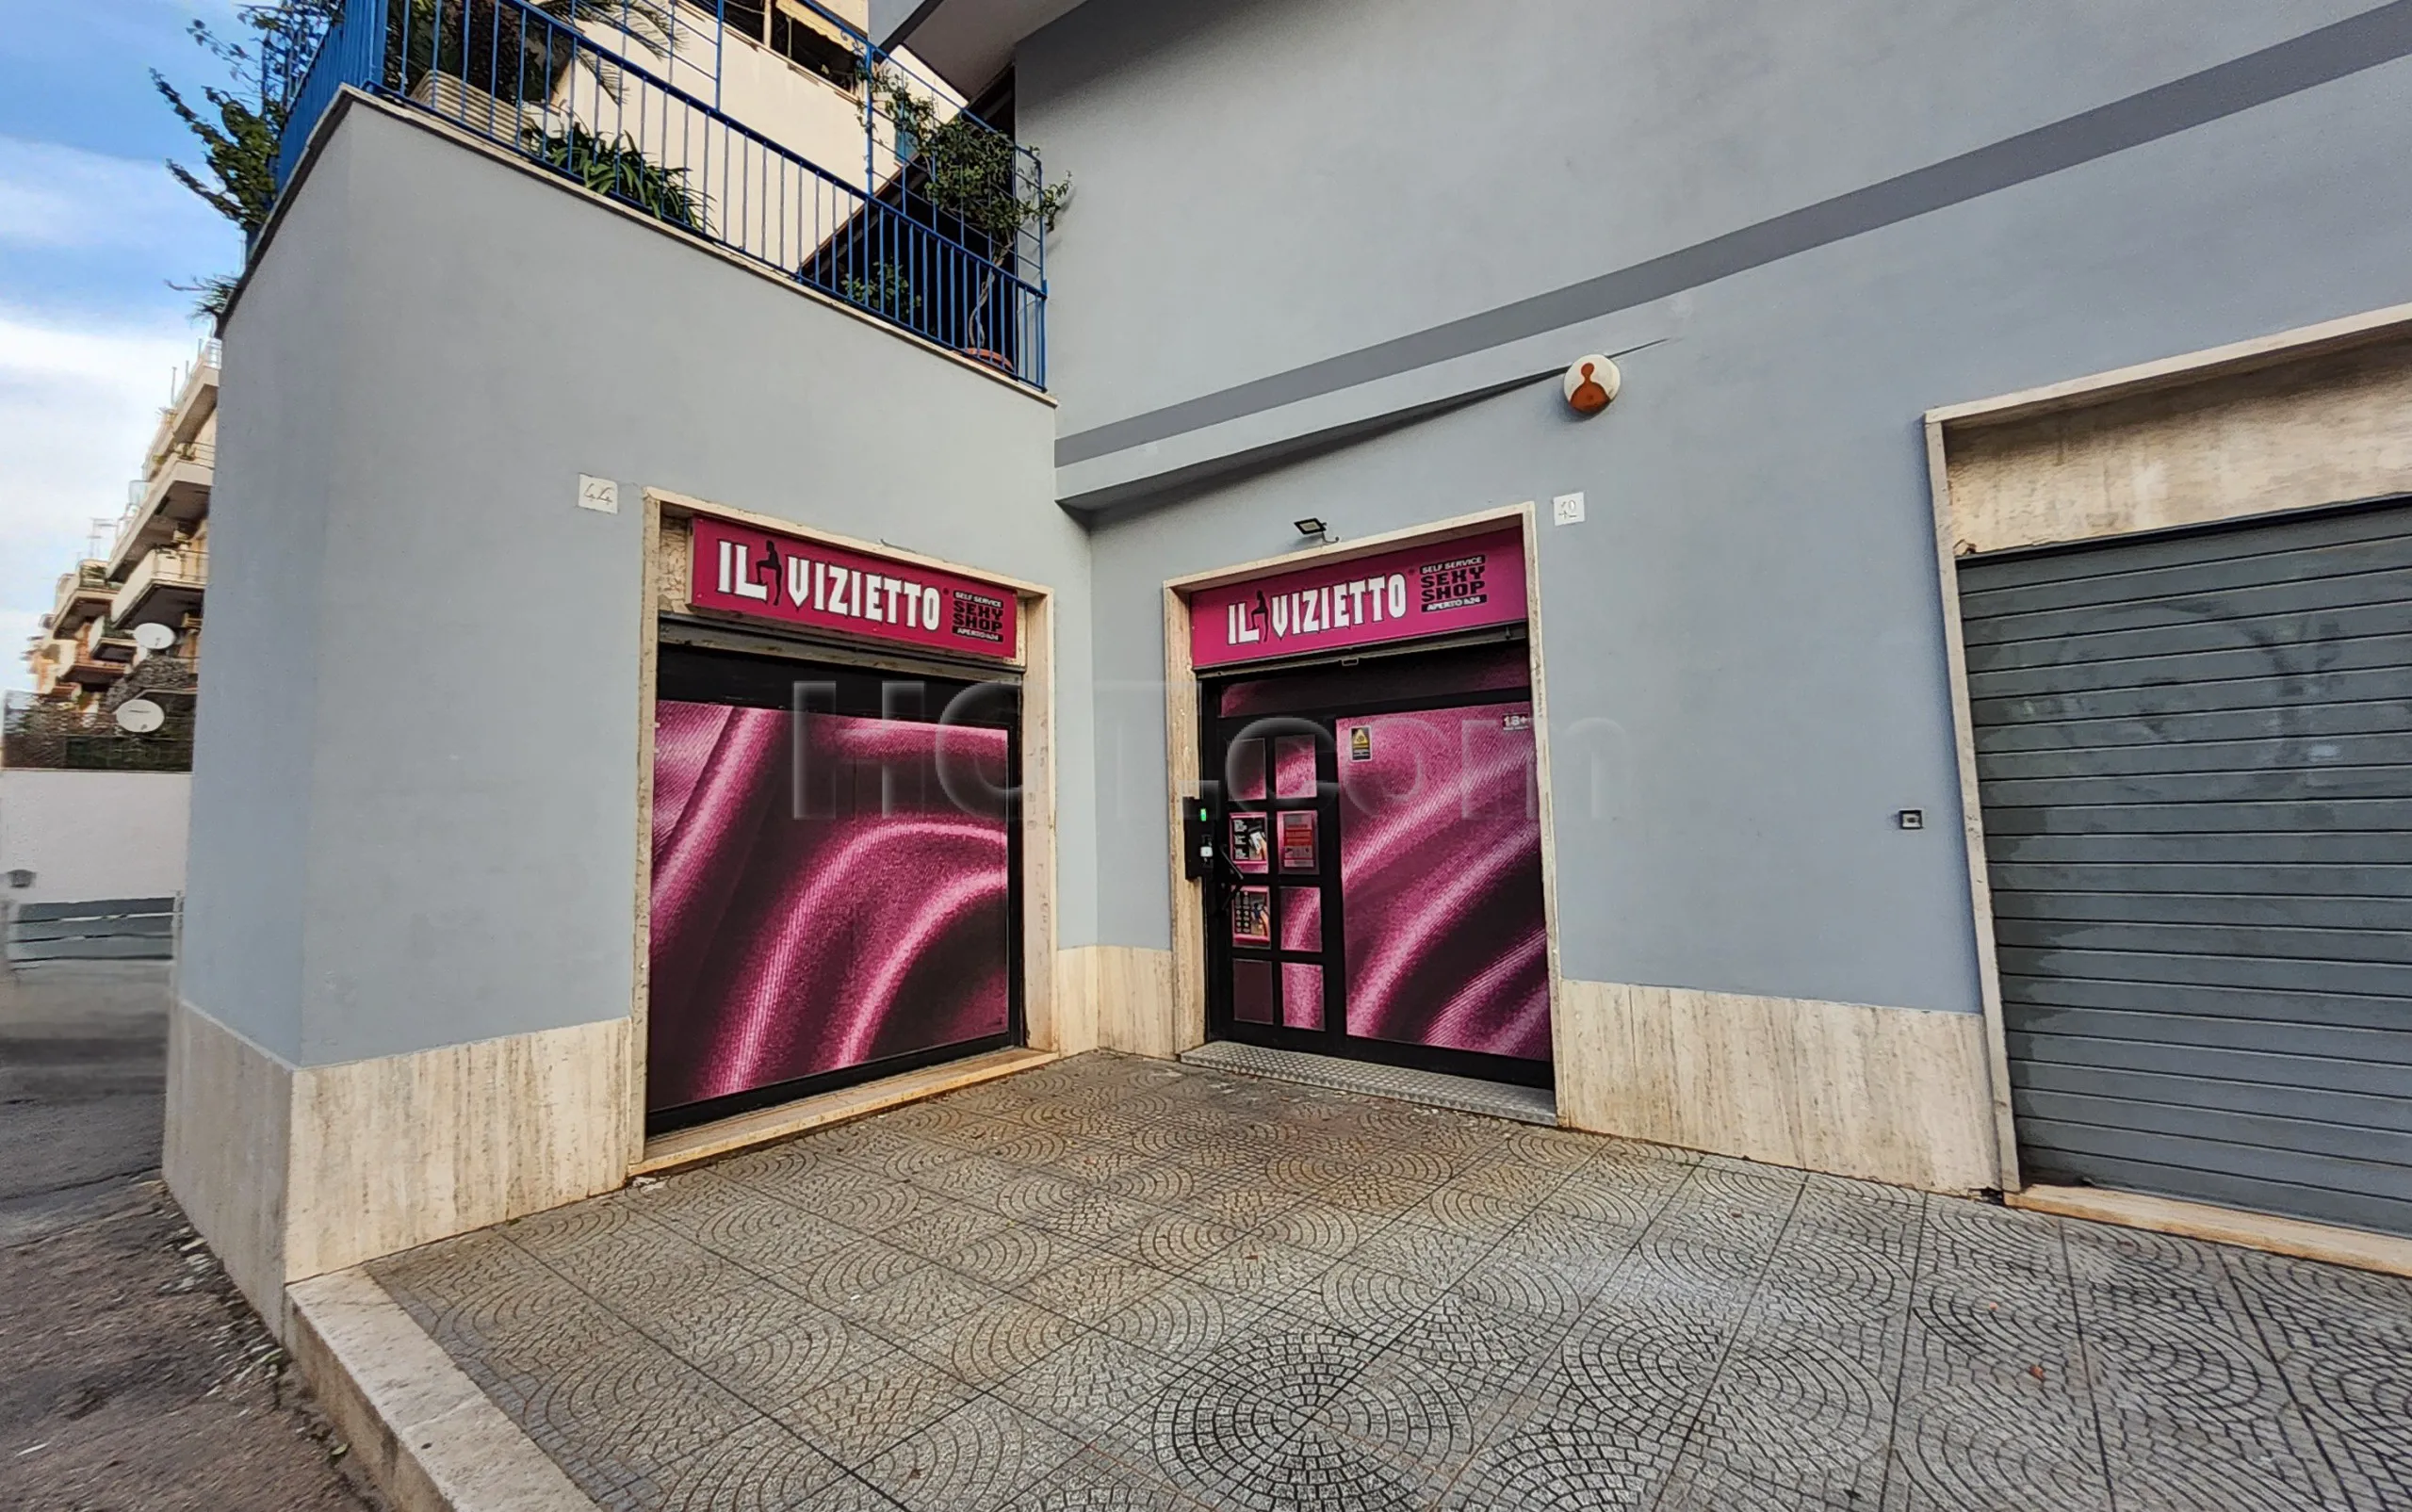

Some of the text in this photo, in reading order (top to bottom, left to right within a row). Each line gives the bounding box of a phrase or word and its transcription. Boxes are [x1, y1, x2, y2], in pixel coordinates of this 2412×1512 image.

[1422, 556, 1482, 574] SELF SERVICE
[716, 539, 941, 632] IL VIZIETTO
[1421, 565, 1486, 589] SEXY
[954, 591, 1002, 608] SELF SERVICE
[1421, 580, 1485, 603] SHOP
[953, 600, 1004, 621] SEXY
[1227, 572, 1407, 645] IL VIZIETTO
[1426, 599, 1463, 611] APERTO
[953, 612, 1003, 632] SHOP
[1504, 715, 1528, 726] 18+
